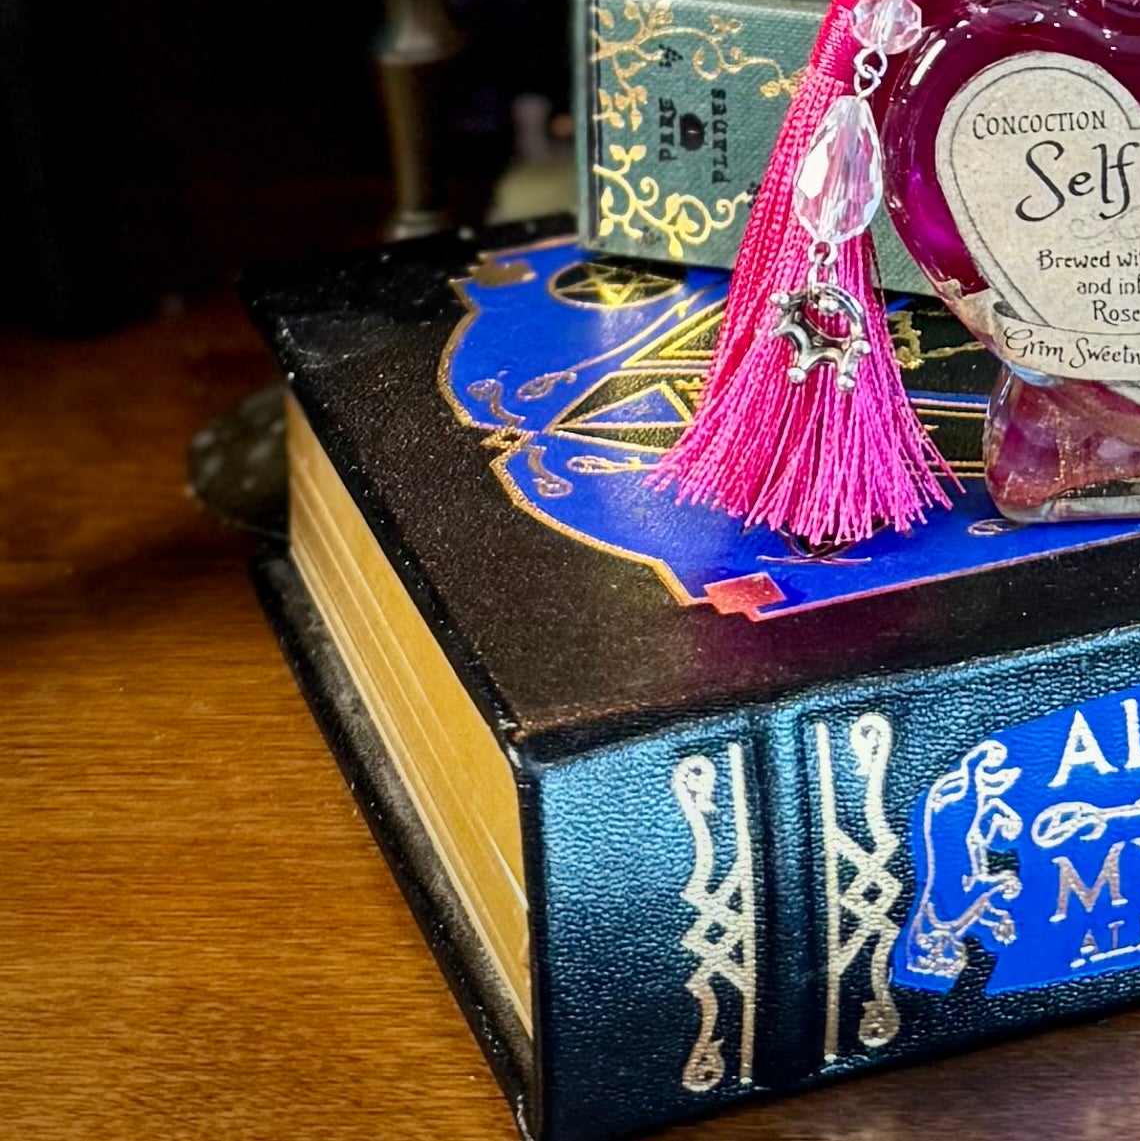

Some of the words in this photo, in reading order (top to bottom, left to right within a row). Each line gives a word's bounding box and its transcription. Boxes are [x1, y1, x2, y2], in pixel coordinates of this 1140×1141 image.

[972, 110, 1106, 139] CONCOCTION
[1015, 139, 1140, 222] Self
[1037, 248, 1111, 271] Brewed
[1076, 277, 1113, 296] and
[1093, 300, 1140, 325] Rose
[1002, 326, 1065, 363] Grim
